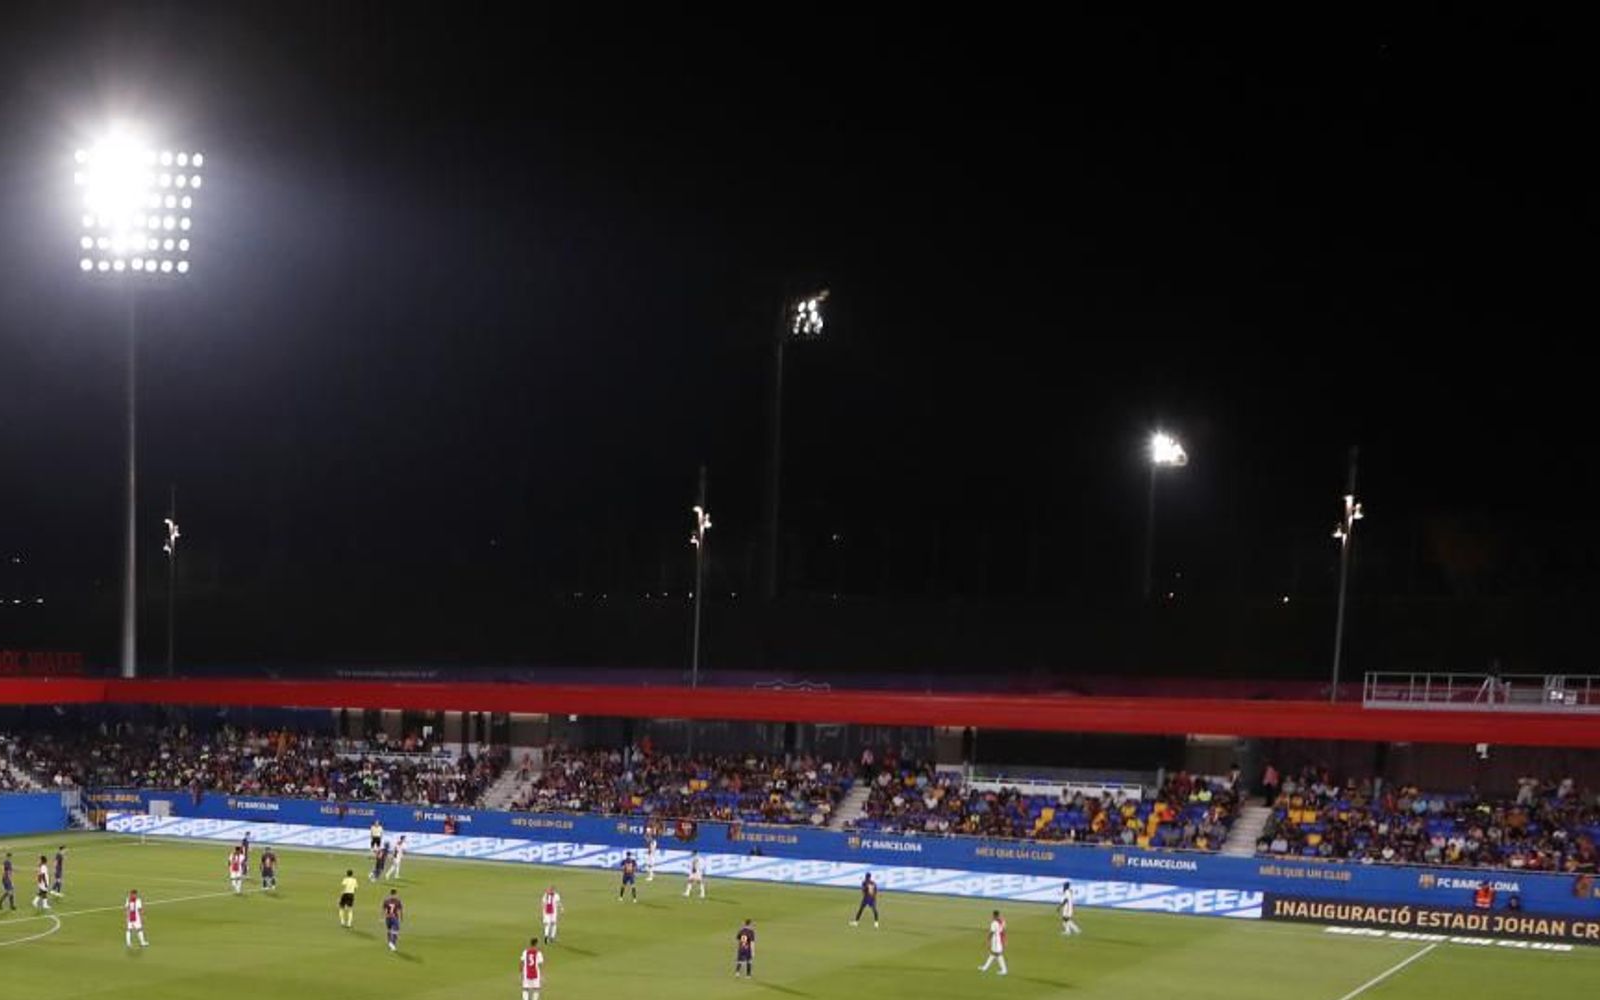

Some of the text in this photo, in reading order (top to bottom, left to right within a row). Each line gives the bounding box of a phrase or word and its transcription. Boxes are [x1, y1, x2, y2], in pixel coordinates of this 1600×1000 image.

[861, 839, 922, 852] FC BARCELONA
[1031, 850, 1055, 861] CLUB
[1127, 856, 1198, 871] FC BARCELONA
[1284, 866, 1305, 879] QUE
[1306, 868, 1323, 879] UN
[1323, 869, 1352, 881] CLUB
[1436, 876, 1520, 893] FC BARCLONA
[1274, 900, 1411, 925] INAUGURACIÓ
[1416, 911, 1489, 931] ESTADI
[1493, 915, 1567, 937] JOHAN
